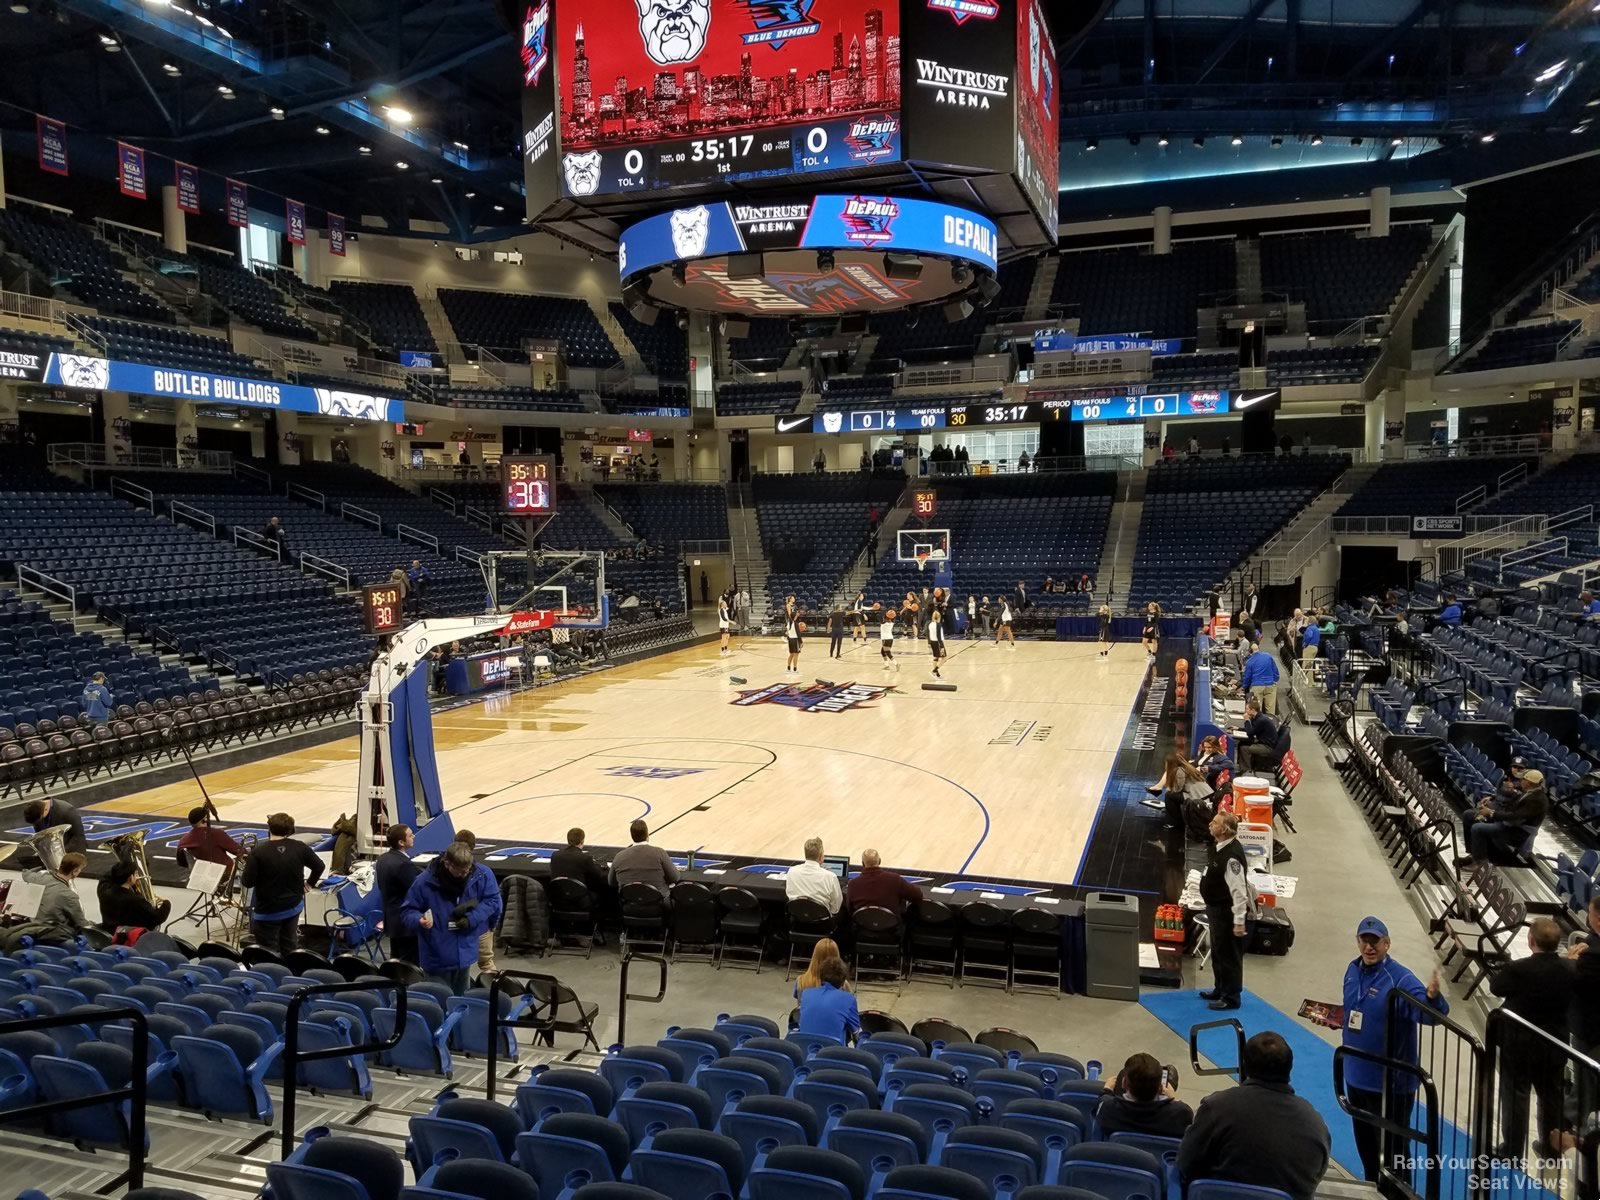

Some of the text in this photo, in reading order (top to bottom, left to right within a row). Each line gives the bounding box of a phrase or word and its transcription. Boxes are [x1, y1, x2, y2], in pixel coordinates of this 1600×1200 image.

[748, 24, 817, 43] BLUE DEMONS
[916, 58, 1008, 92] WINTRUST
[935, 89, 990, 109] ARENA
[525, 112, 553, 149] WINTRUST
[762, 143, 773, 151] 00
[807, 127, 828, 153] 0
[531, 140, 549, 164] ARENA
[691, 135, 754, 161] 35:17
[624, 149, 643, 174] 0
[676, 153, 686, 162] 00
[802, 156, 829, 167] TOL 4
[124, 163, 140, 173] NCAA
[717, 163, 731, 173] 1st
[618, 177, 645, 187] TOL 4
[735, 205, 810, 219] WINTRUST
[291, 217, 302, 229] 24
[749, 221, 795, 233] ARENA
[331, 230, 342, 242] 99
[944, 215, 993, 254] DEPAUL
[154, 370, 281, 405] BUTLER BULLDOGS
[1043, 400, 1071, 408] PERIOD
[1126, 404, 1136, 416] 4
[1154, 399, 1164, 413] 0
[951, 413, 966, 425] 30
[985, 406, 1028, 422] 35:17
[1053, 408, 1060, 419] 1
[1083, 406, 1100, 418] 00
[863, 414, 872, 428] 0
[887, 417, 896, 429] 4
[921, 414, 935, 427] 00
[510, 464, 546, 480] 35:17
[515, 481, 543, 508] 30
[918, 500, 932, 512] 30
[372, 591, 397, 606] 35:17
[377, 607, 391, 625] 30
[1132, 722, 1159, 750] CHICAGO
